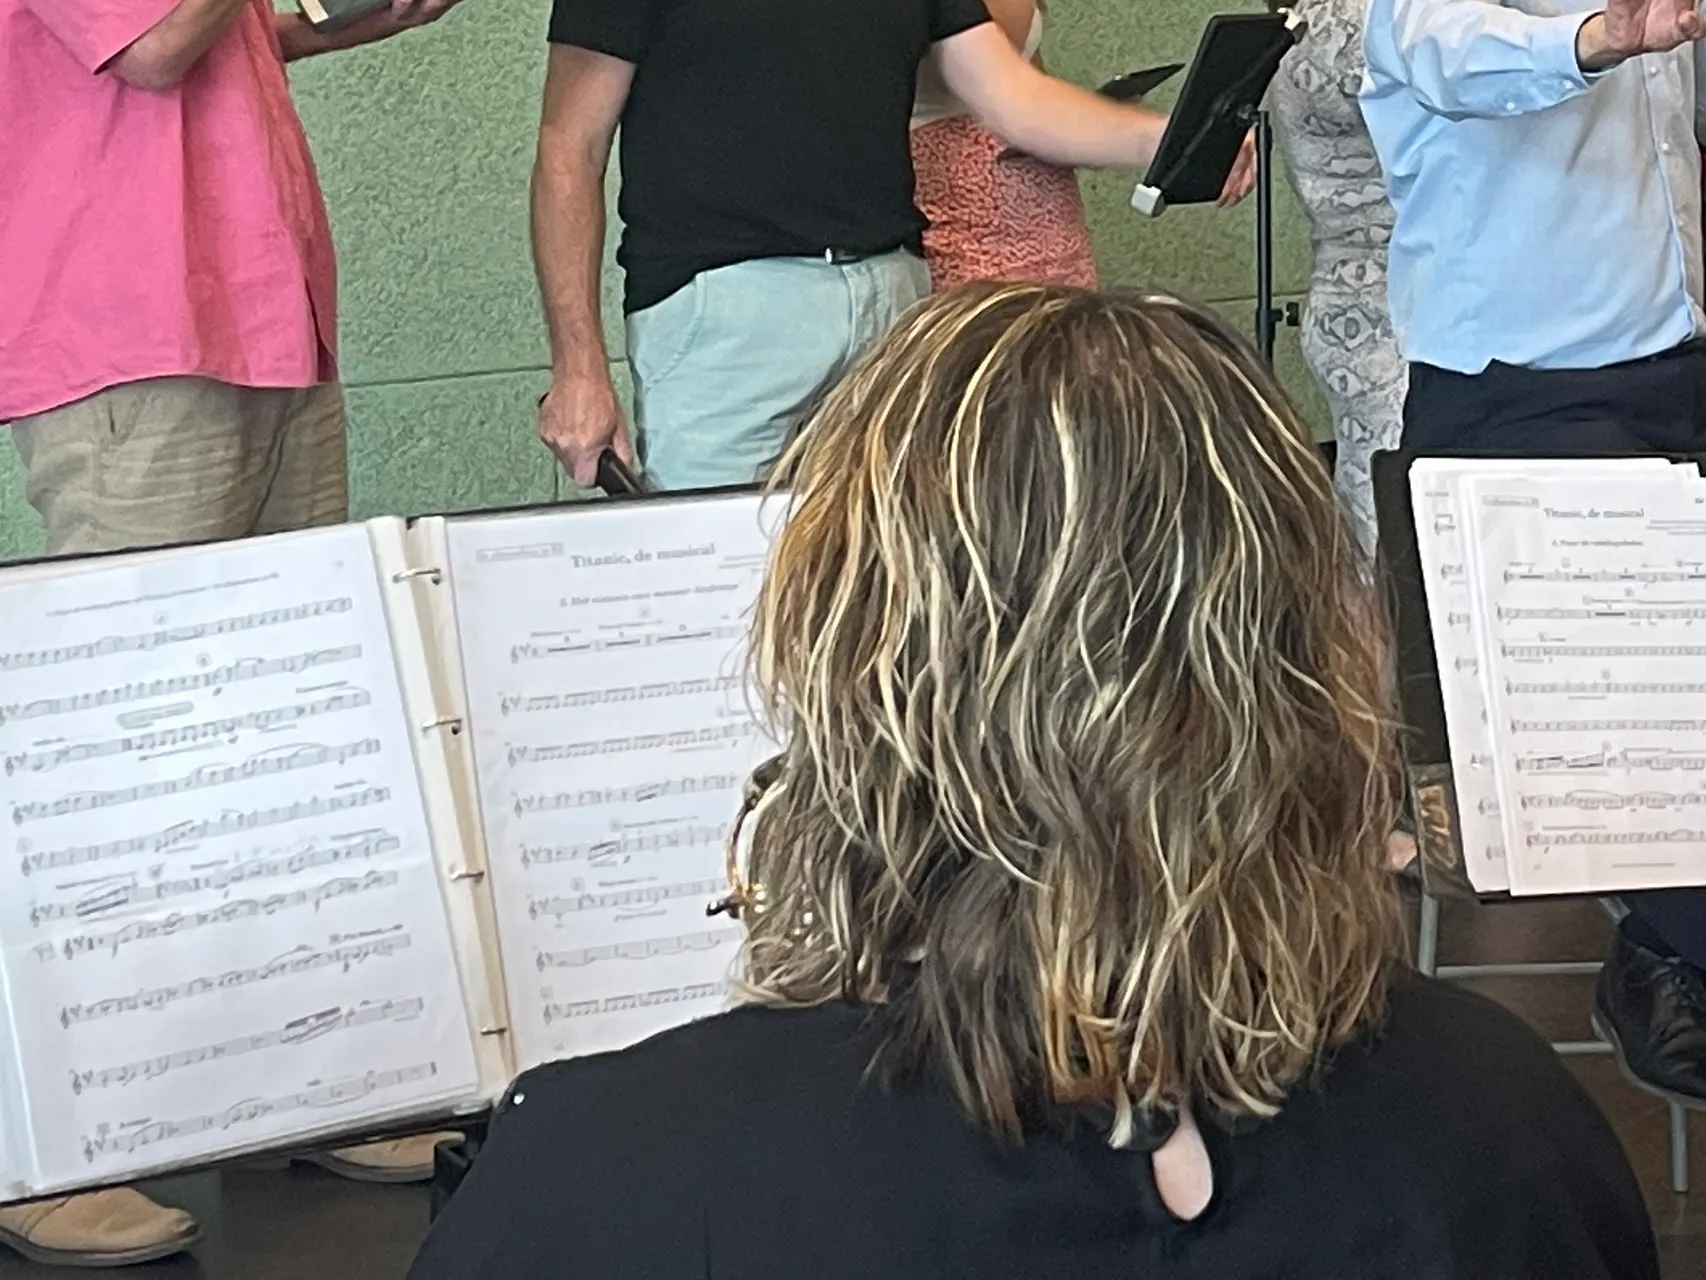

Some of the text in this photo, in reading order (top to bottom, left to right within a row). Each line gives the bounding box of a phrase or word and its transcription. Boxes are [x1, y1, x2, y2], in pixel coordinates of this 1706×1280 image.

[570, 542, 716, 569] Titanic, de musical
